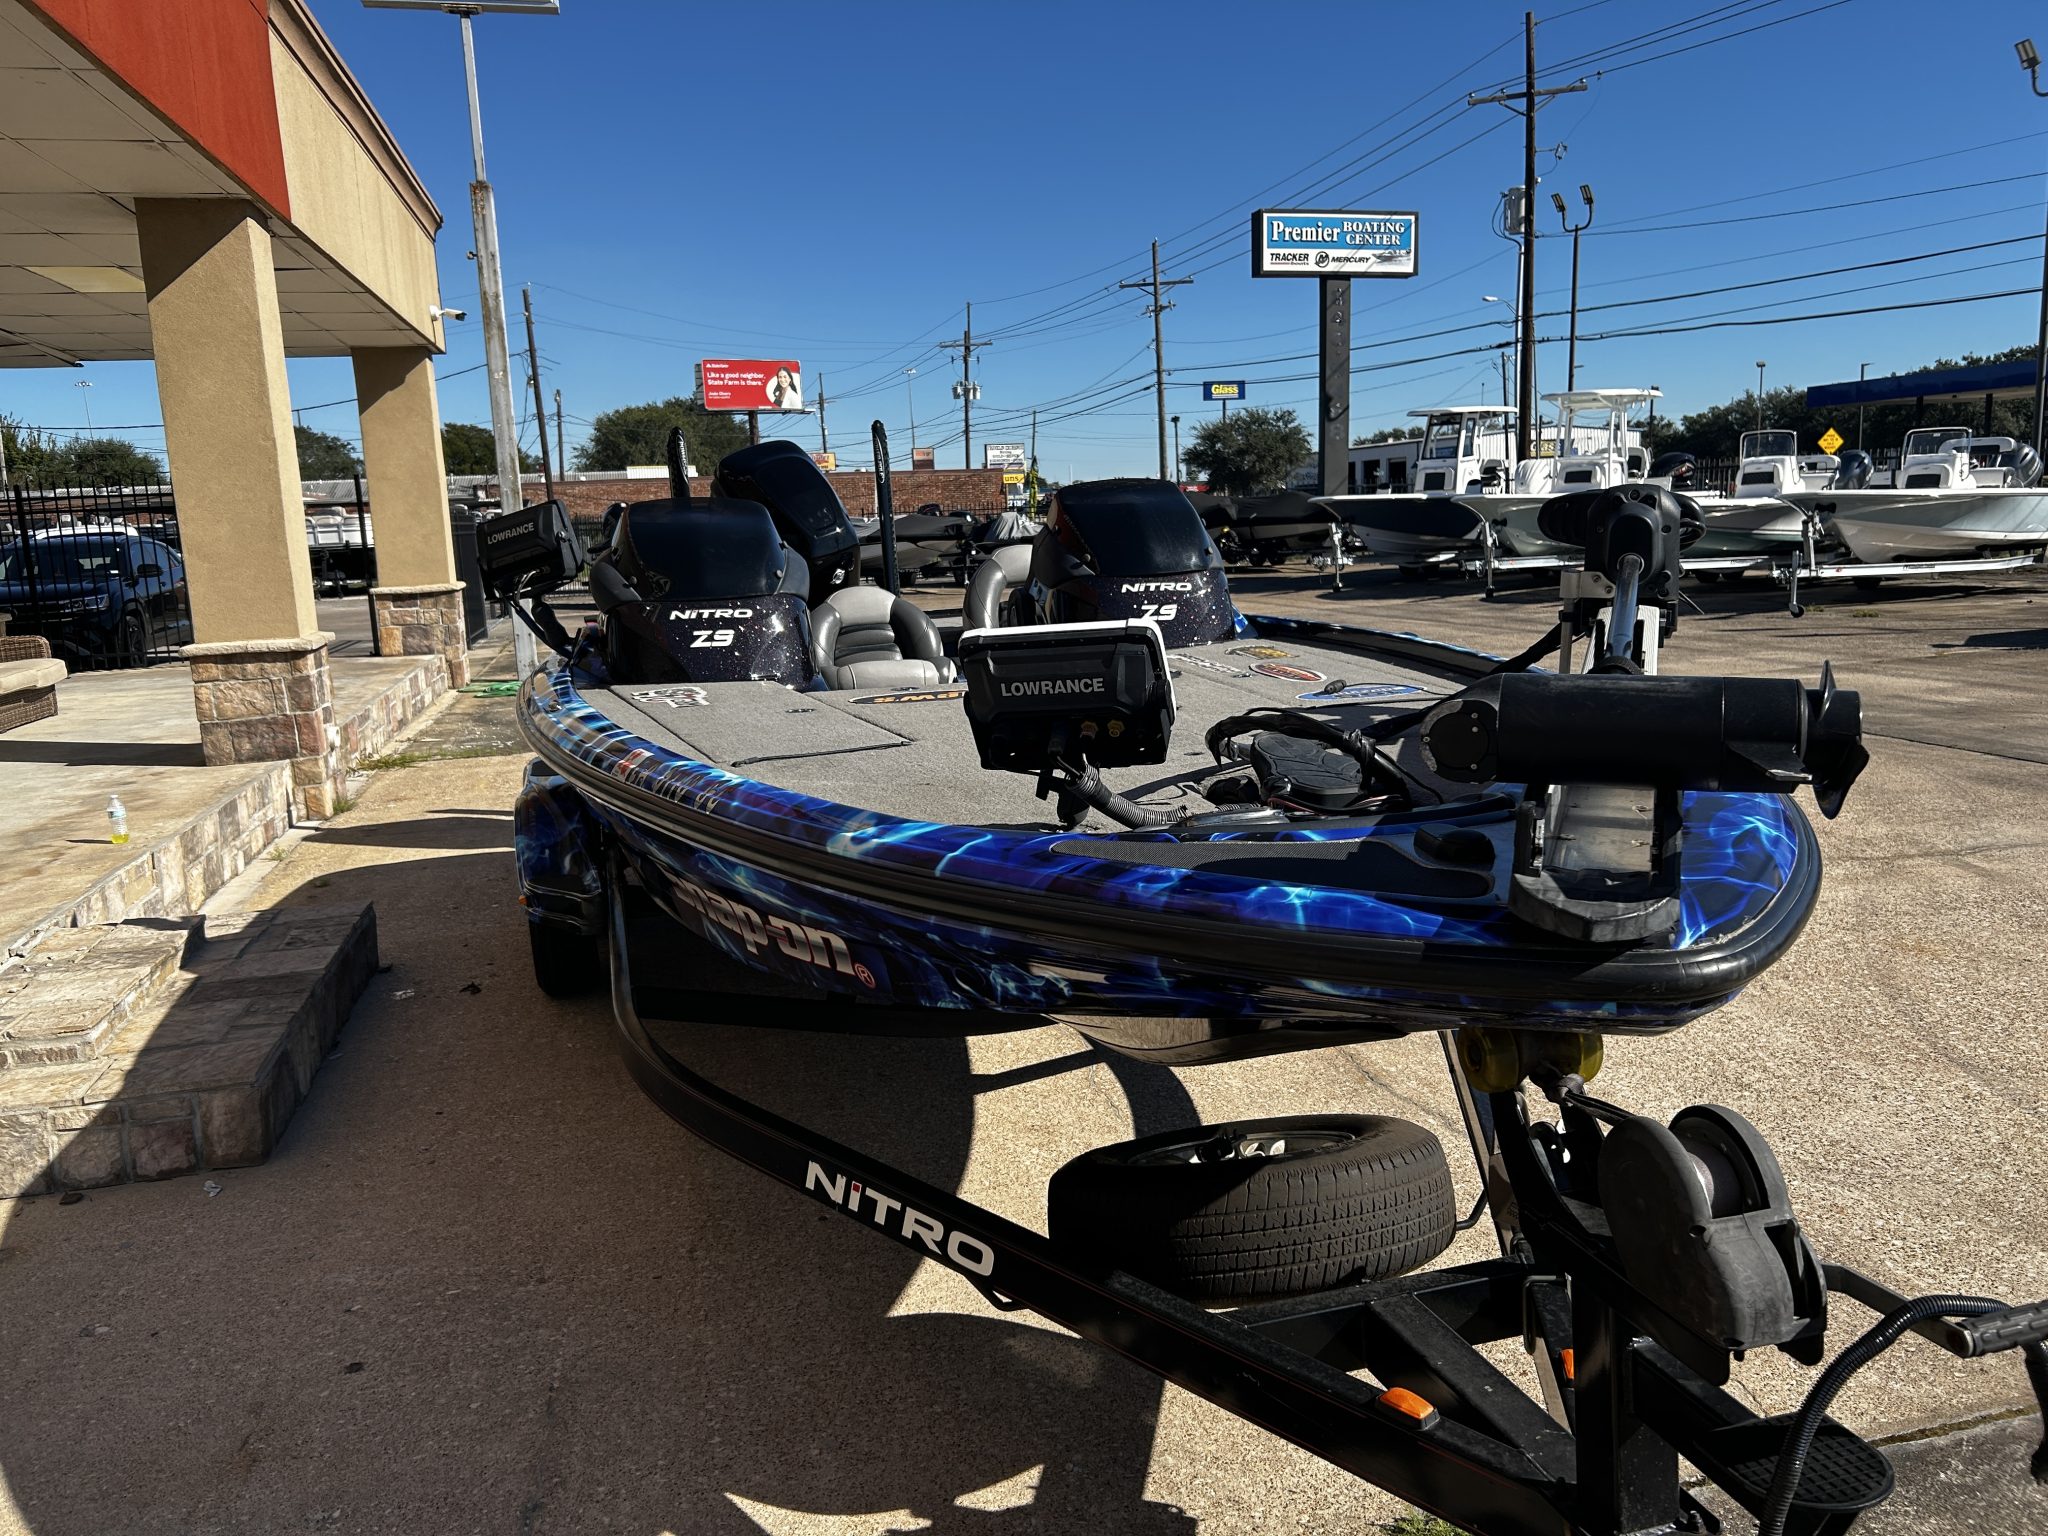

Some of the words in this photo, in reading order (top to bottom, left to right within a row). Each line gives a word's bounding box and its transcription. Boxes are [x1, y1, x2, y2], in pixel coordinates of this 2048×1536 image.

[1271, 220, 1340, 242] Premier
[1342, 221, 1405, 233] BOATING
[1345, 233, 1401, 246] CENTER
[1270, 253, 1309, 262] TRACKER
[1331, 256, 1371, 264] MERCURY
[1211, 384, 1239, 394] Glass
[487, 522, 535, 545] LOWRANCE
[1121, 582, 1192, 593] NITRO
[669, 608, 753, 620] NITRO
[690, 629, 735, 648] Z9
[1000, 678, 1105, 697] LOWRANCE
[805, 1160, 994, 1276] NITRO
